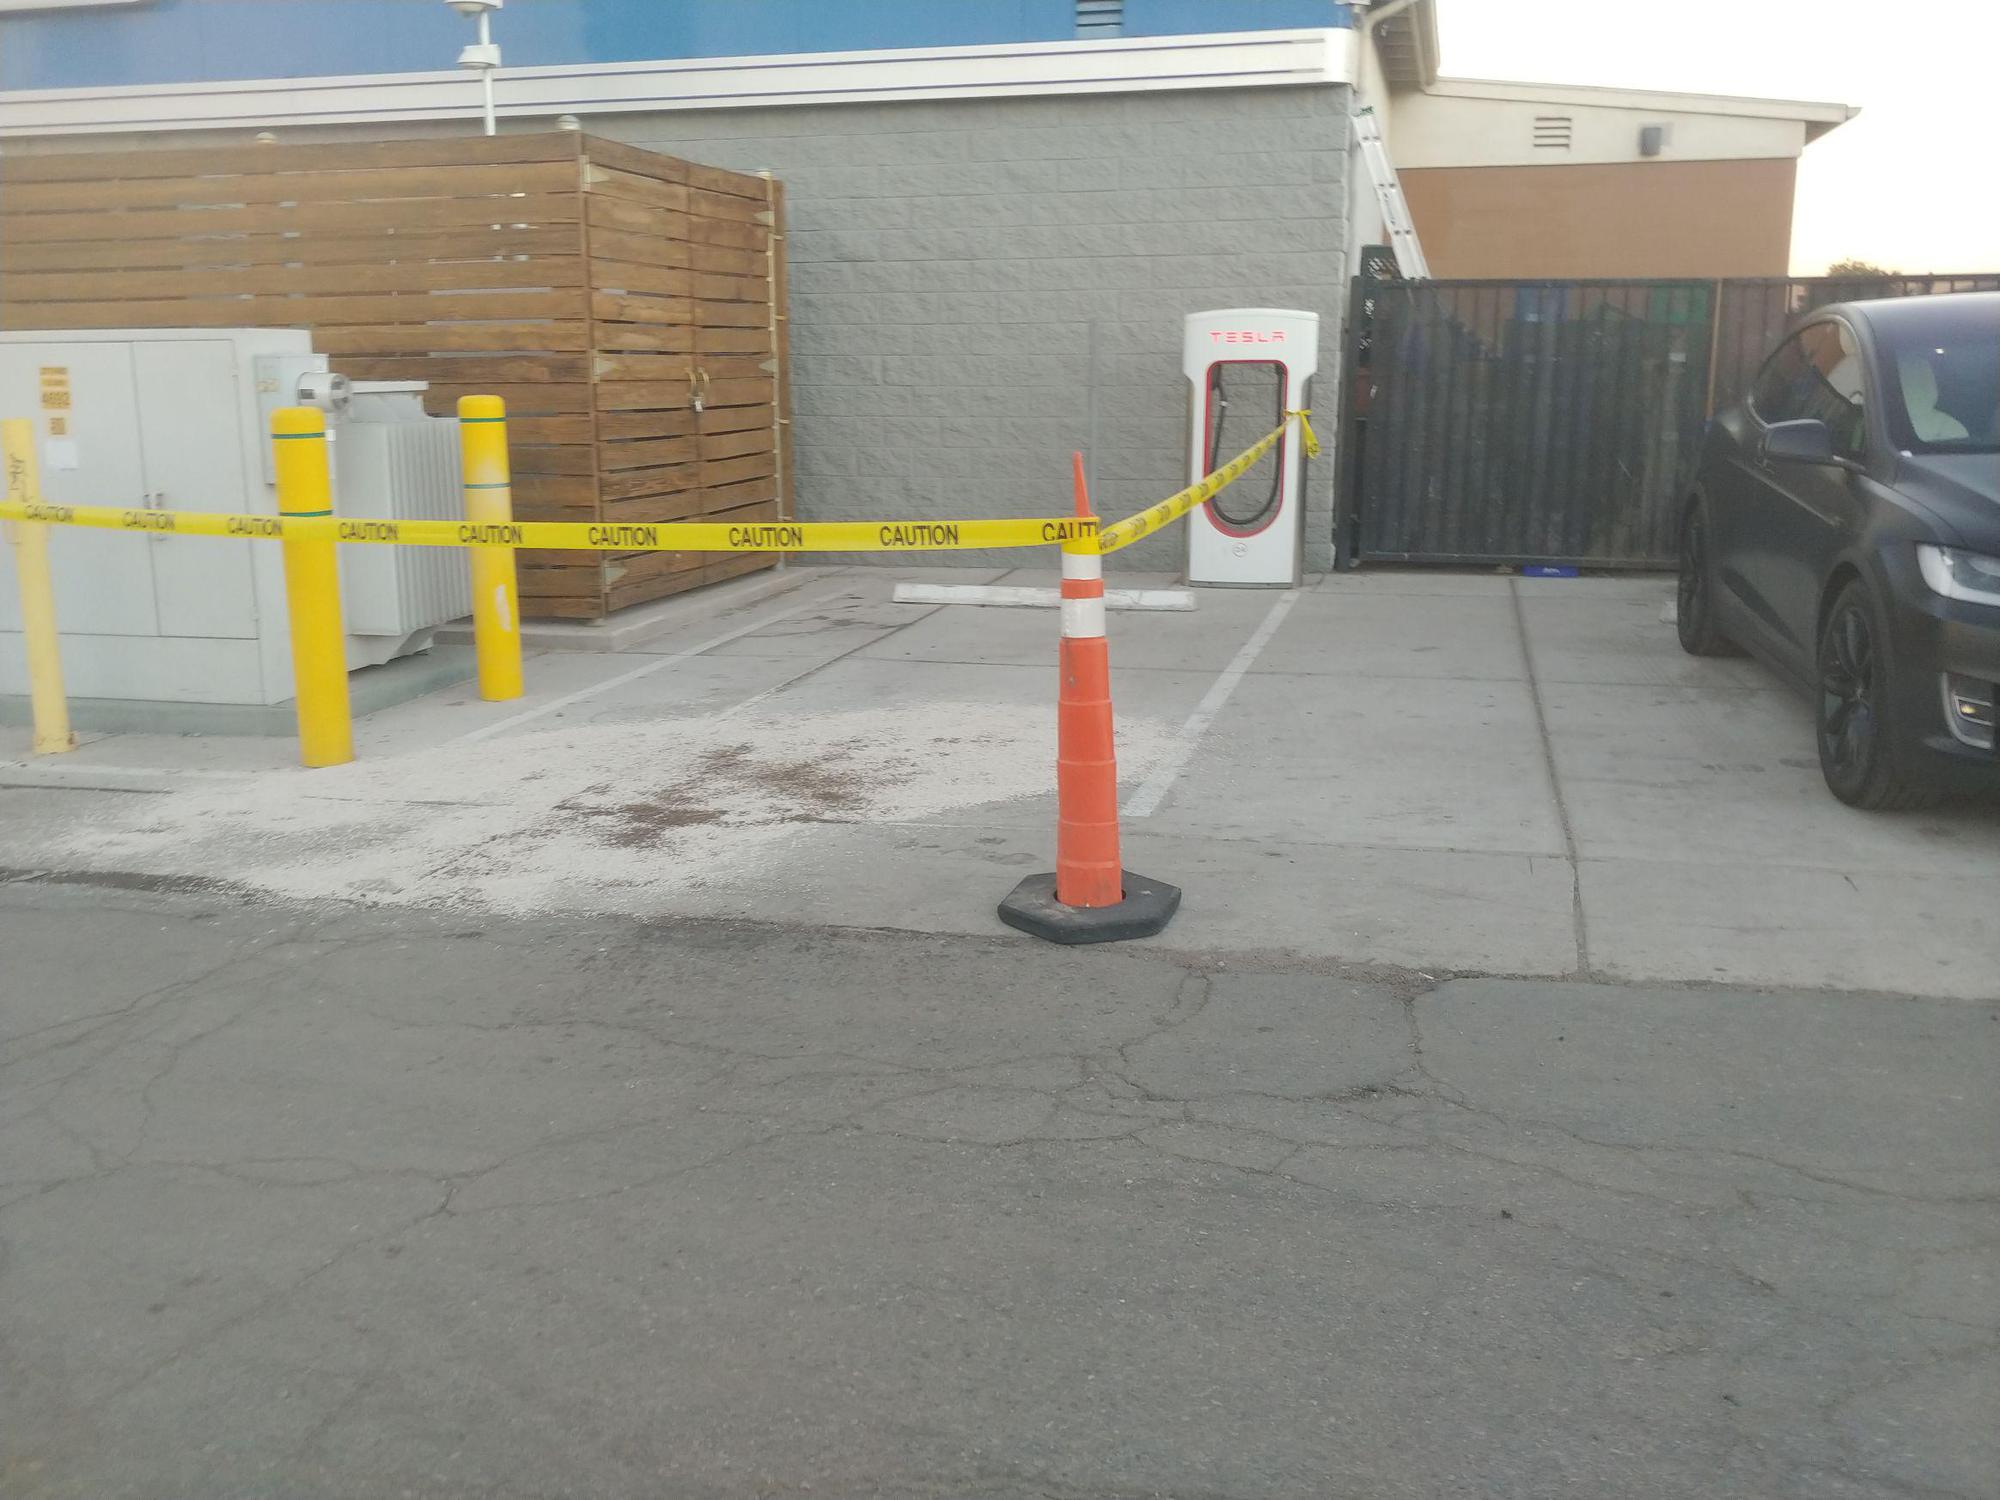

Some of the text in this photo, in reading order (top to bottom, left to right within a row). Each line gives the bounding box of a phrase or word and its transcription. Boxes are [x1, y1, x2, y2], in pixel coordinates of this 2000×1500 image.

[1208, 331, 1284, 343] TESLA
[122, 511, 176, 530] CAUTION
[226, 517, 283, 536] CAUTION
[338, 522, 399, 541] CAUTION
[458, 525, 523, 544] CAUTION
[588, 526, 658, 546] CAUTION
[728, 527, 803, 547] CAUTION
[879, 525, 959, 546] CAUTION
